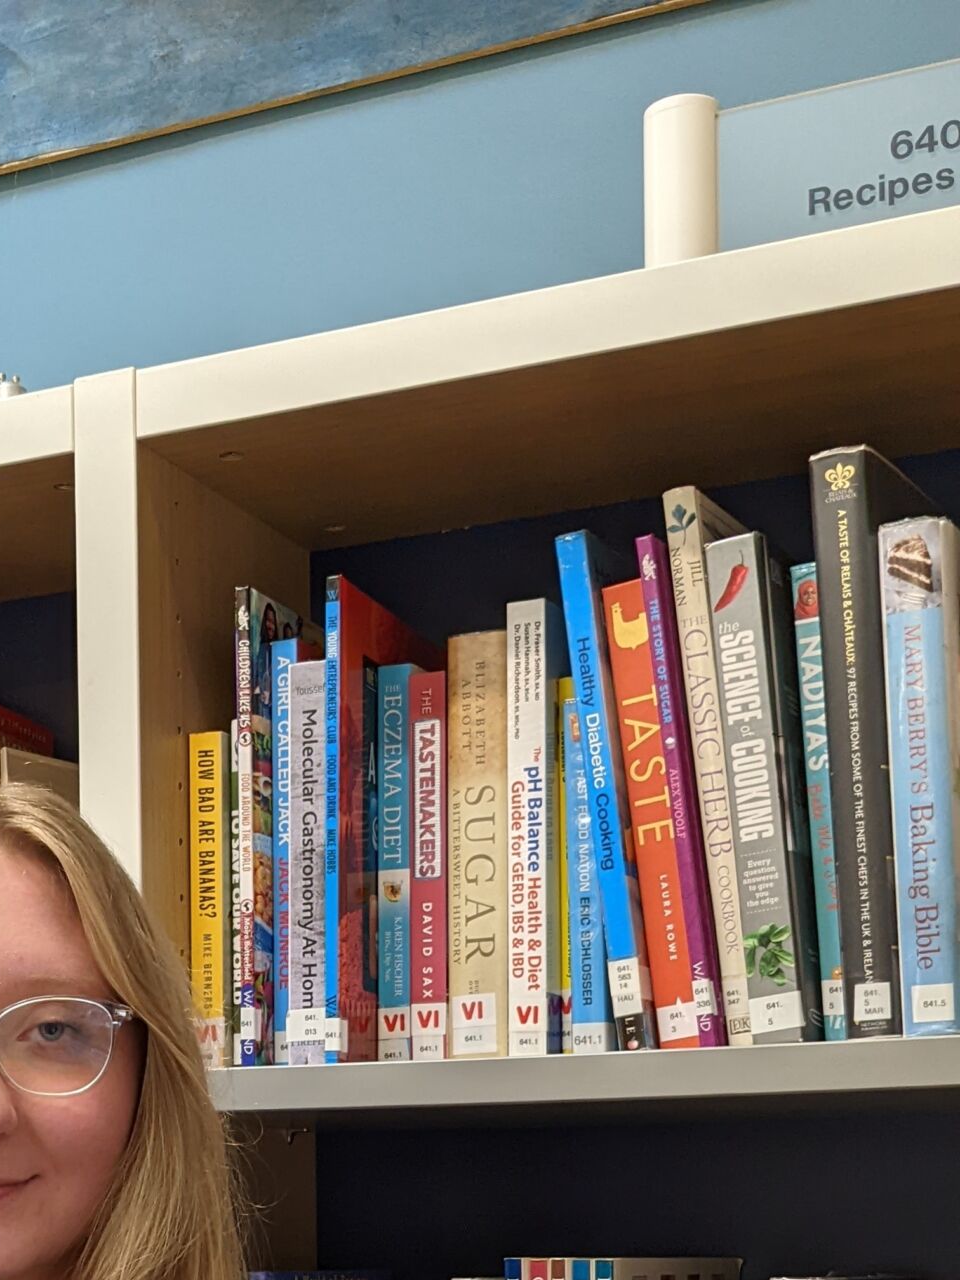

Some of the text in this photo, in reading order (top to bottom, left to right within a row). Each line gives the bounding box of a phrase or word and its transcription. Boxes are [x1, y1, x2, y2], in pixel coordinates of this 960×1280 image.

[808, 167, 955, 216] Recipes
[890, 120, 960, 160] 640
[242, 773, 250, 792] FOOD
[383, 694, 400, 863] ECZEMA DIET
[575, 637, 617, 871] Healthy Diabetic Cooking
[621, 685, 674, 846] TASTE
[719, 628, 775, 841] SCIENCE of COOKING
[799, 636, 828, 770] NADIYA'S
[198, 750, 216, 918] HOW BAD ARE BANANAS?
[242, 795, 251, 826] AROUND
[243, 845, 251, 872] WORLD
[299, 709, 318, 1009] Molecular Gastronomy At Hom
[418, 688, 437, 998] THE TASTEMAKERS DAVID SAX
[464, 785, 496, 965] SUGAR
[524, 746, 542, 991] The pH Balance Health & Diet
[683, 628, 738, 954] CLASSIC HERB COOKBOOK
[904, 624, 939, 970] MARY BERRY'S Baking Bible
